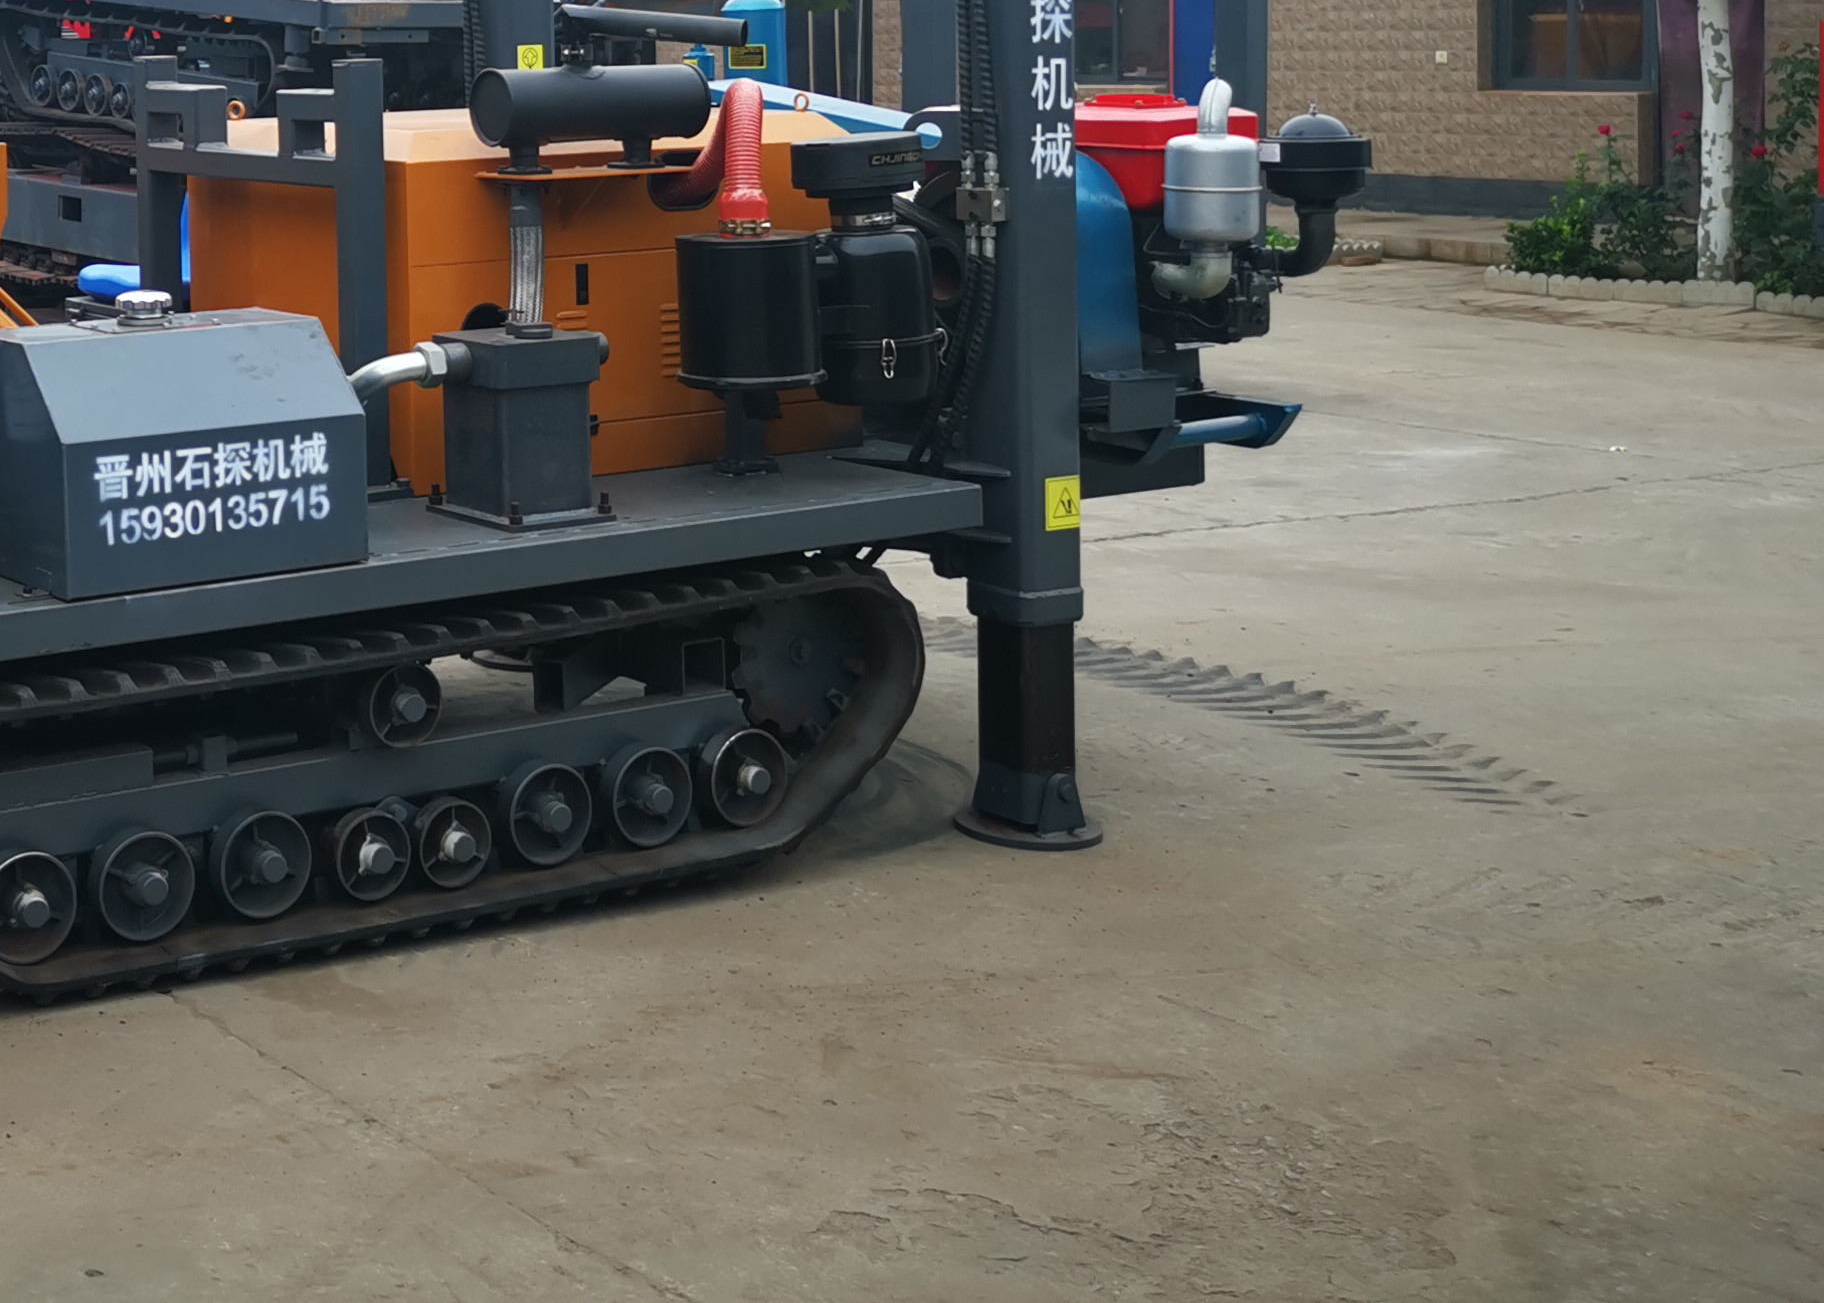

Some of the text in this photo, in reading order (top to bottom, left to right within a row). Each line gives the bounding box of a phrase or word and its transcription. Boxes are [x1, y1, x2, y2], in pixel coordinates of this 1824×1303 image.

[94, 432, 329, 502] 晋州石探机械
[99, 484, 331, 546] 15930135715
